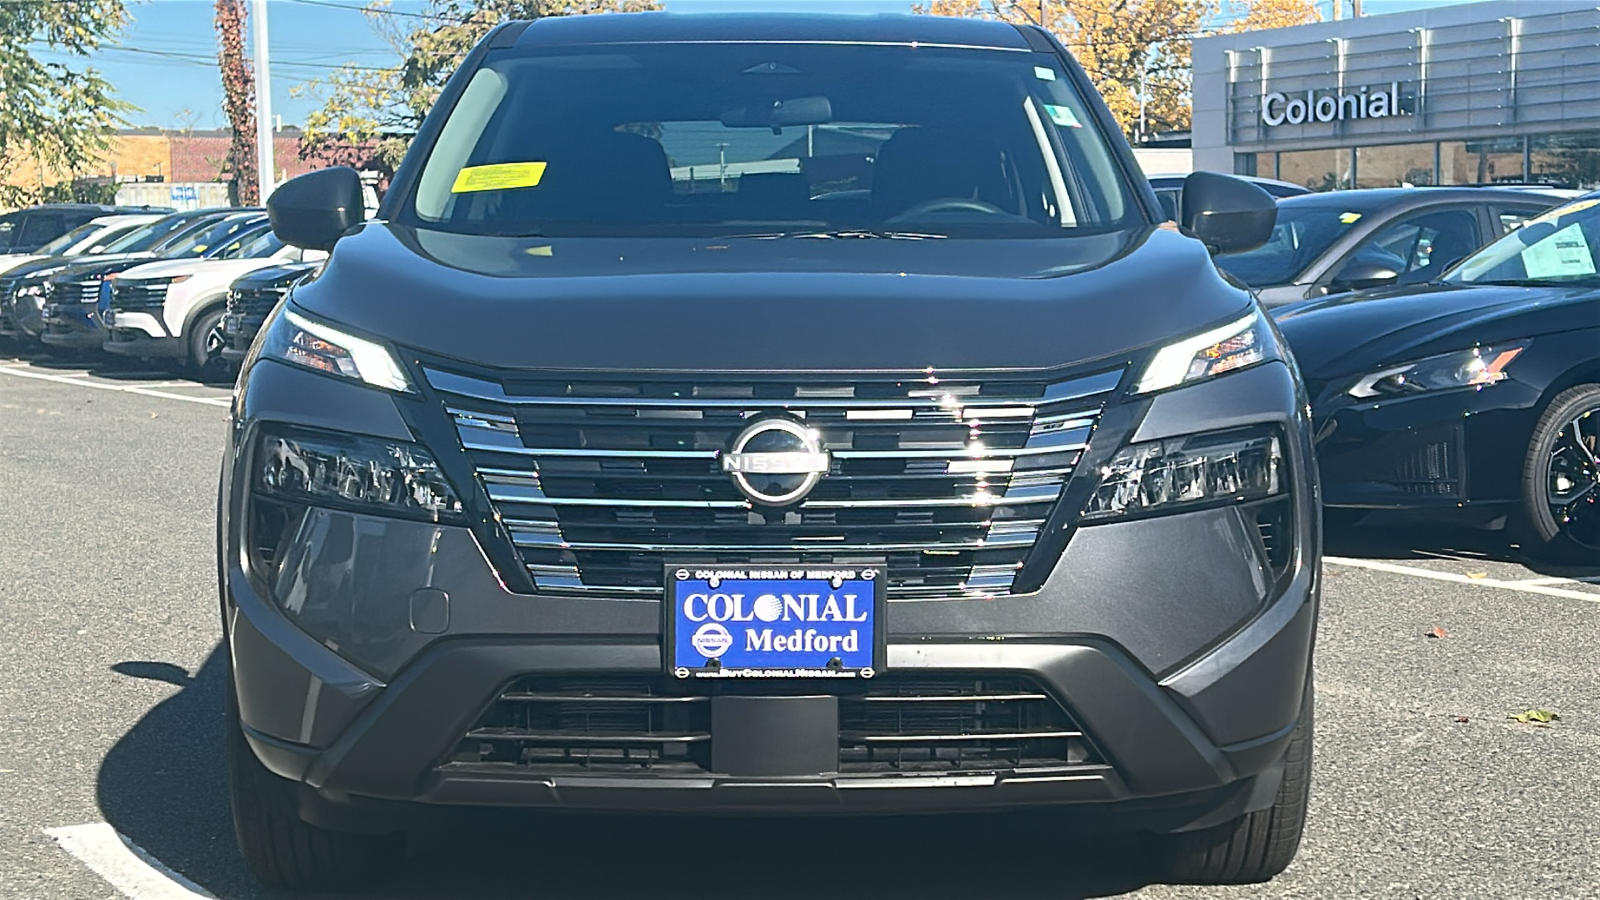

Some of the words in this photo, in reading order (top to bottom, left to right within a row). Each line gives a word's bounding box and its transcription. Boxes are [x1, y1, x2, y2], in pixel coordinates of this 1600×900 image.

[1262, 82, 1398, 126] Colonial
[724, 456, 827, 470] NISS
[695, 570, 748, 579] COLONIAL
[749, 570, 788, 579] NISSAN
[789, 570, 804, 579] OF
[806, 570, 856, 579] MEDFORD
[683, 594, 868, 622] COLONIAL
[745, 628, 859, 652] Medford
